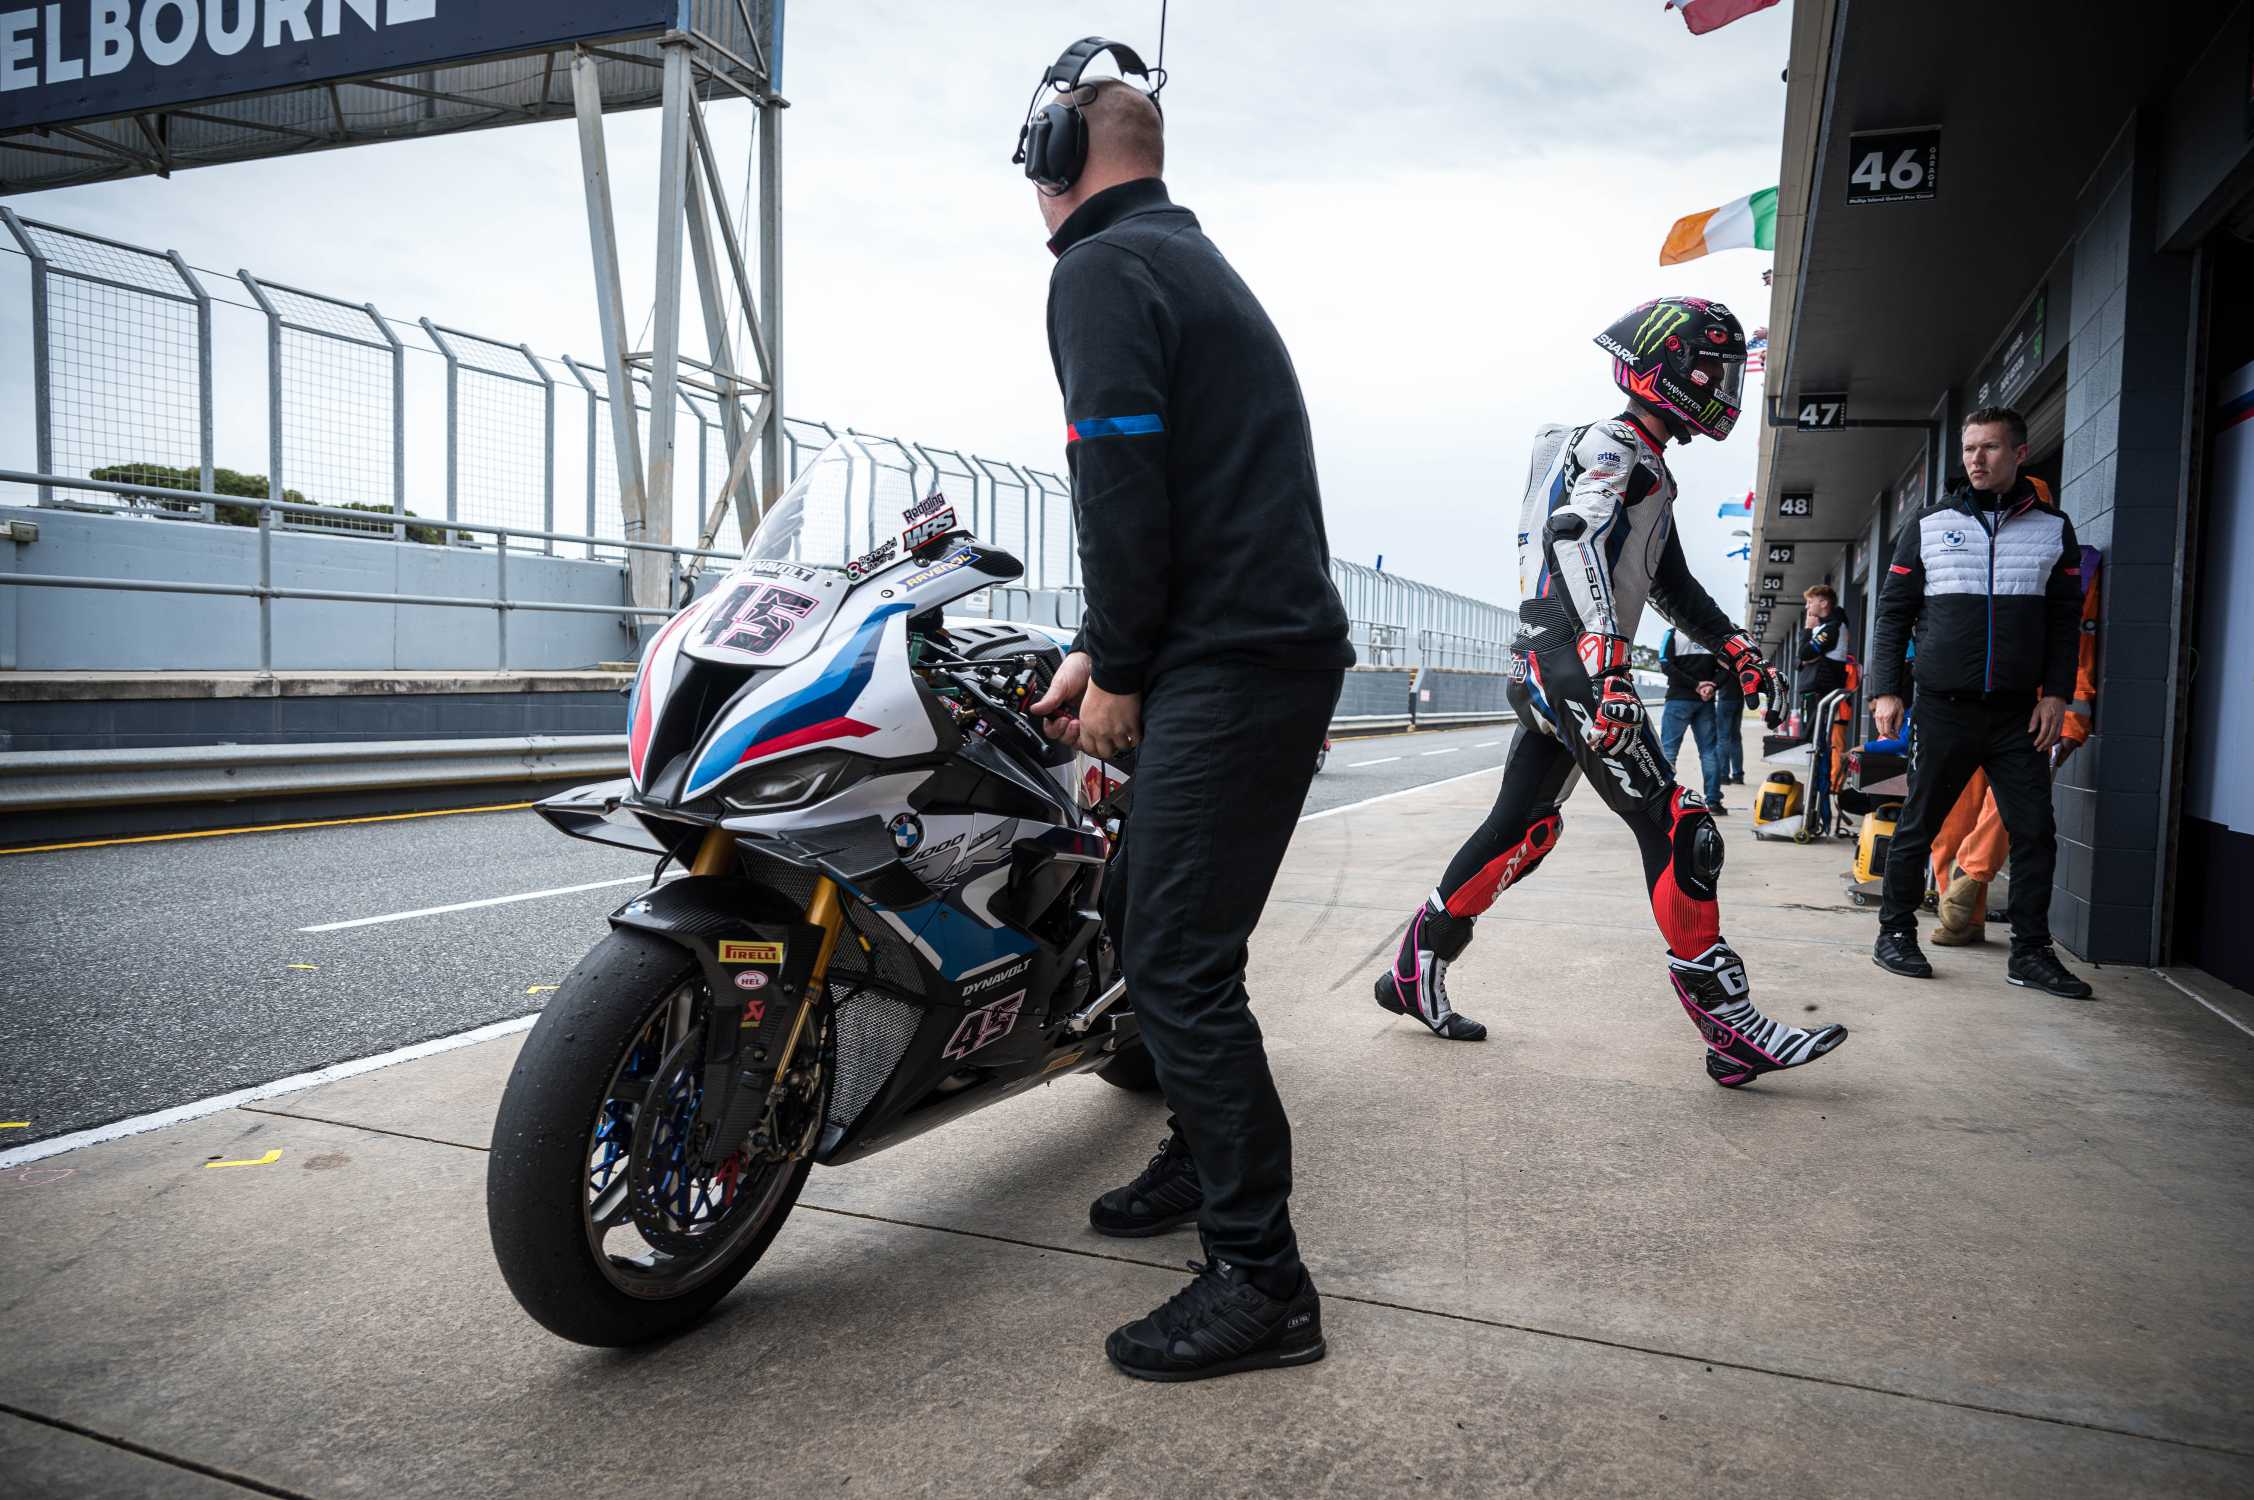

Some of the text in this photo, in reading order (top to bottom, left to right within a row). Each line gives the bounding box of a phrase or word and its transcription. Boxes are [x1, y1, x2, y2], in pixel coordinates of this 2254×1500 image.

[1851, 149, 1924, 191] 46
[1597, 334, 1641, 367] SHARK
[1799, 403, 1840, 425] 47
[1780, 499, 1808, 514] 48
[905, 510, 955, 549] WRS
[906, 551, 972, 587] RAVENOL
[1769, 549, 1791, 562] 49
[1585, 567, 1602, 601] 50
[1763, 579, 1780, 589] 50
[1759, 598, 1773, 607] 51
[725, 944, 777, 960] PIRELLI
[741, 978, 760, 986] HEL
[962, 958, 1033, 997] DYNAVOLT
[942, 988, 1027, 1061] 45
